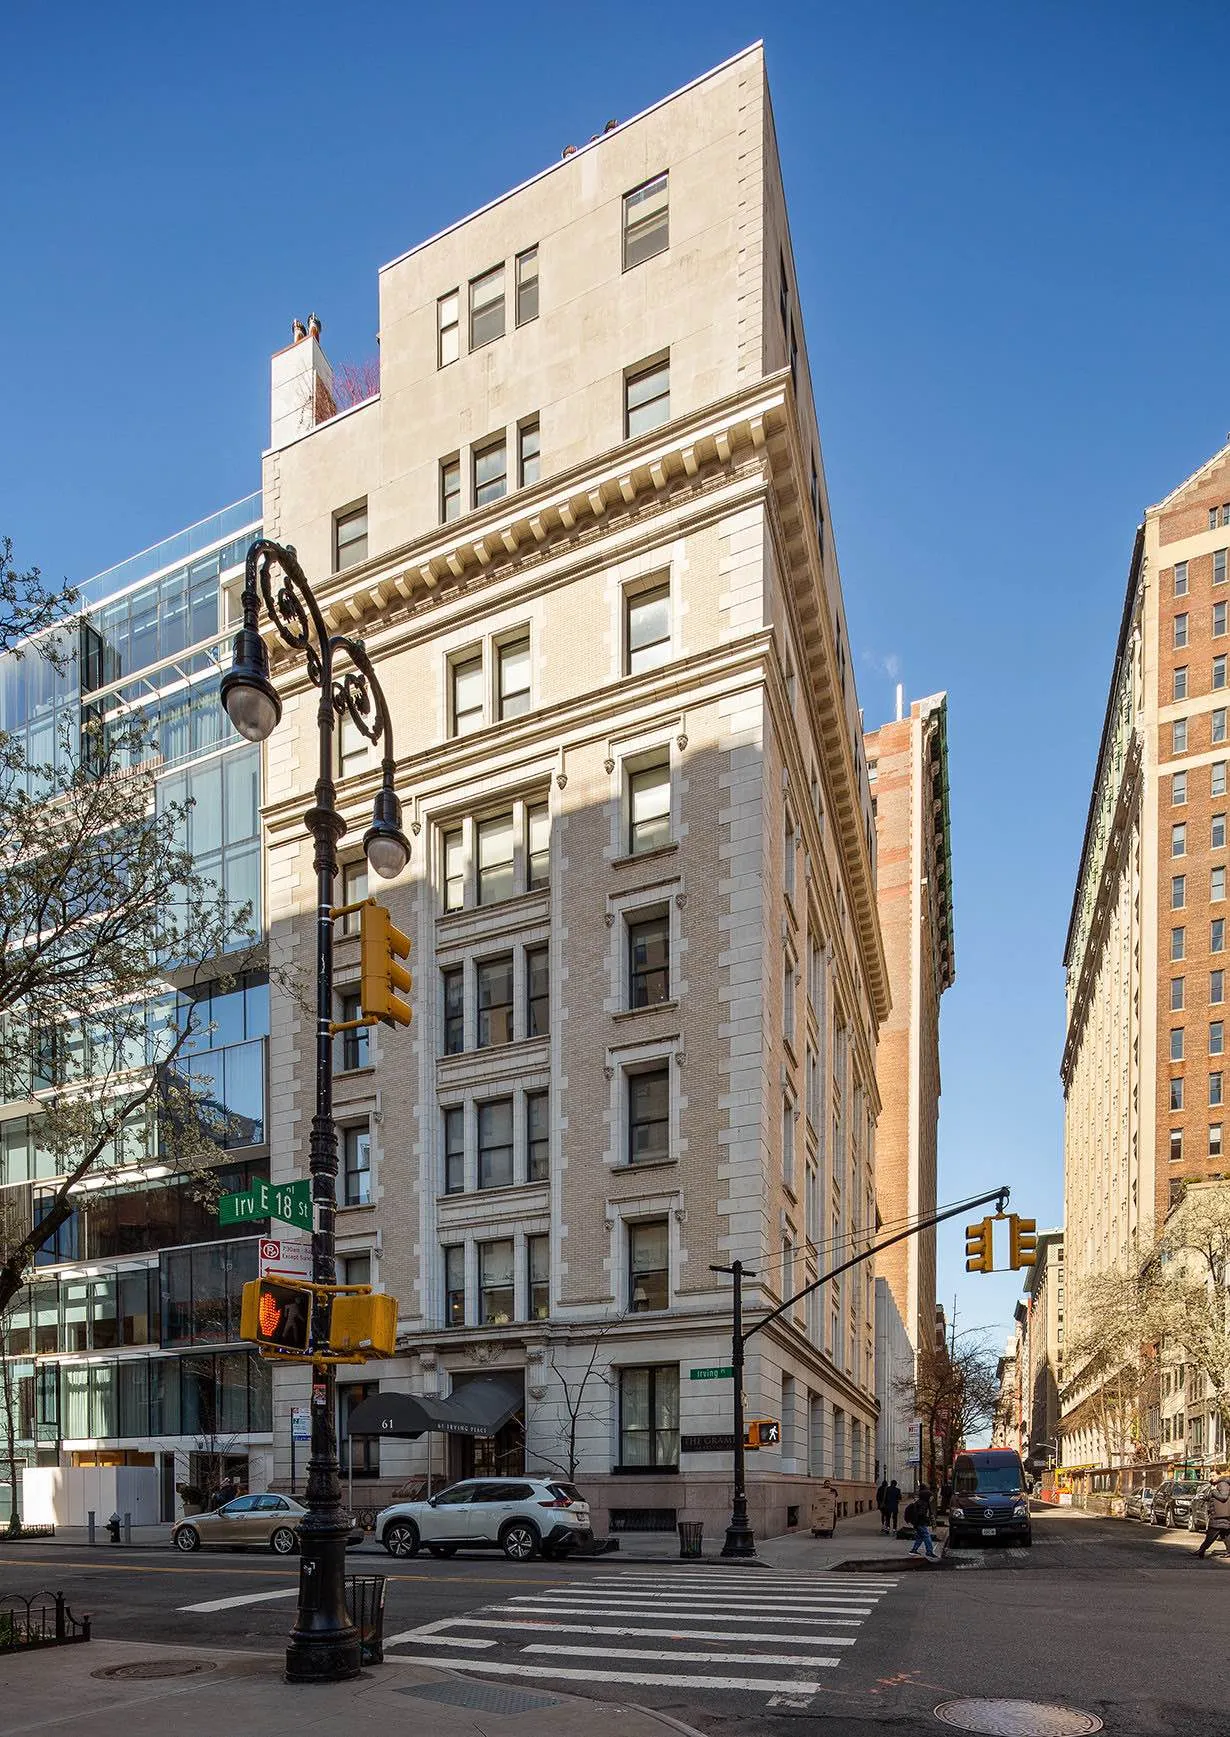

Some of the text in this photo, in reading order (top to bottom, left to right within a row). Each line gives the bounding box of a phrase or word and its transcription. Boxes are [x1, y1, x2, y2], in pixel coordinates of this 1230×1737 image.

[235, 1197, 254, 1217] Irv
[261, 1185, 308, 1219] E 18 St
[697, 1369, 719, 1379] Irving
[381, 1419, 393, 1429] 61
